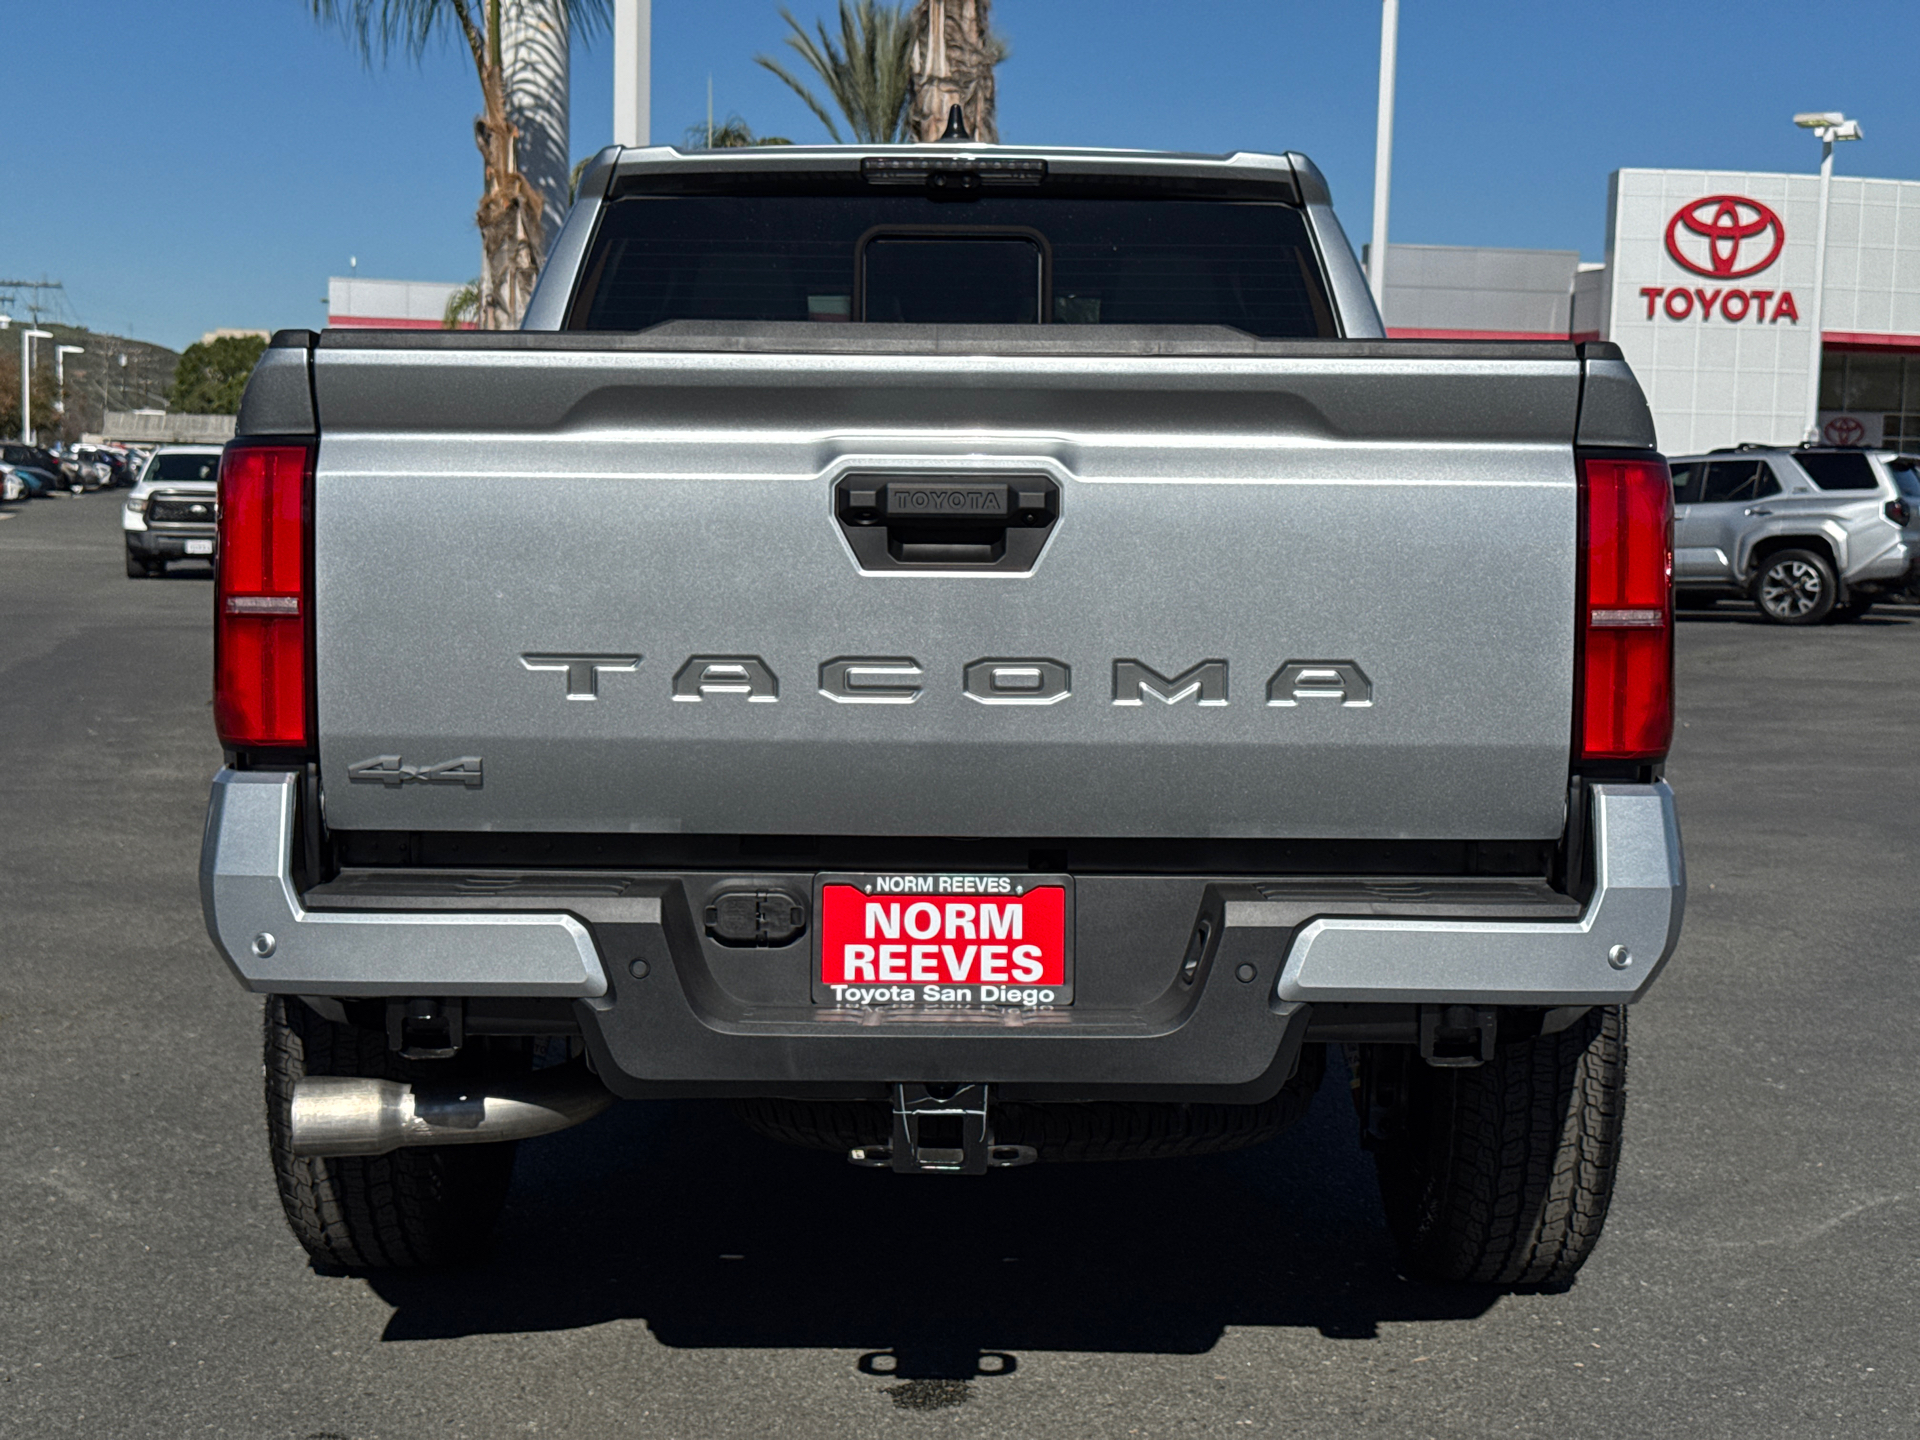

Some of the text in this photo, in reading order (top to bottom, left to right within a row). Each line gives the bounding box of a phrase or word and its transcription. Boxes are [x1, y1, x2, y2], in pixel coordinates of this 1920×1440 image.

[1640, 287, 1799, 323] TOYOTA
[894, 491, 1001, 510] TOYOTA
[519, 652, 1374, 707] TACOMA
[876, 876, 1011, 893] NORM REEVES
[865, 902, 1023, 940] NORM
[843, 944, 1044, 982] REEVES
[830, 984, 1055, 1006] Toyota San Diego
